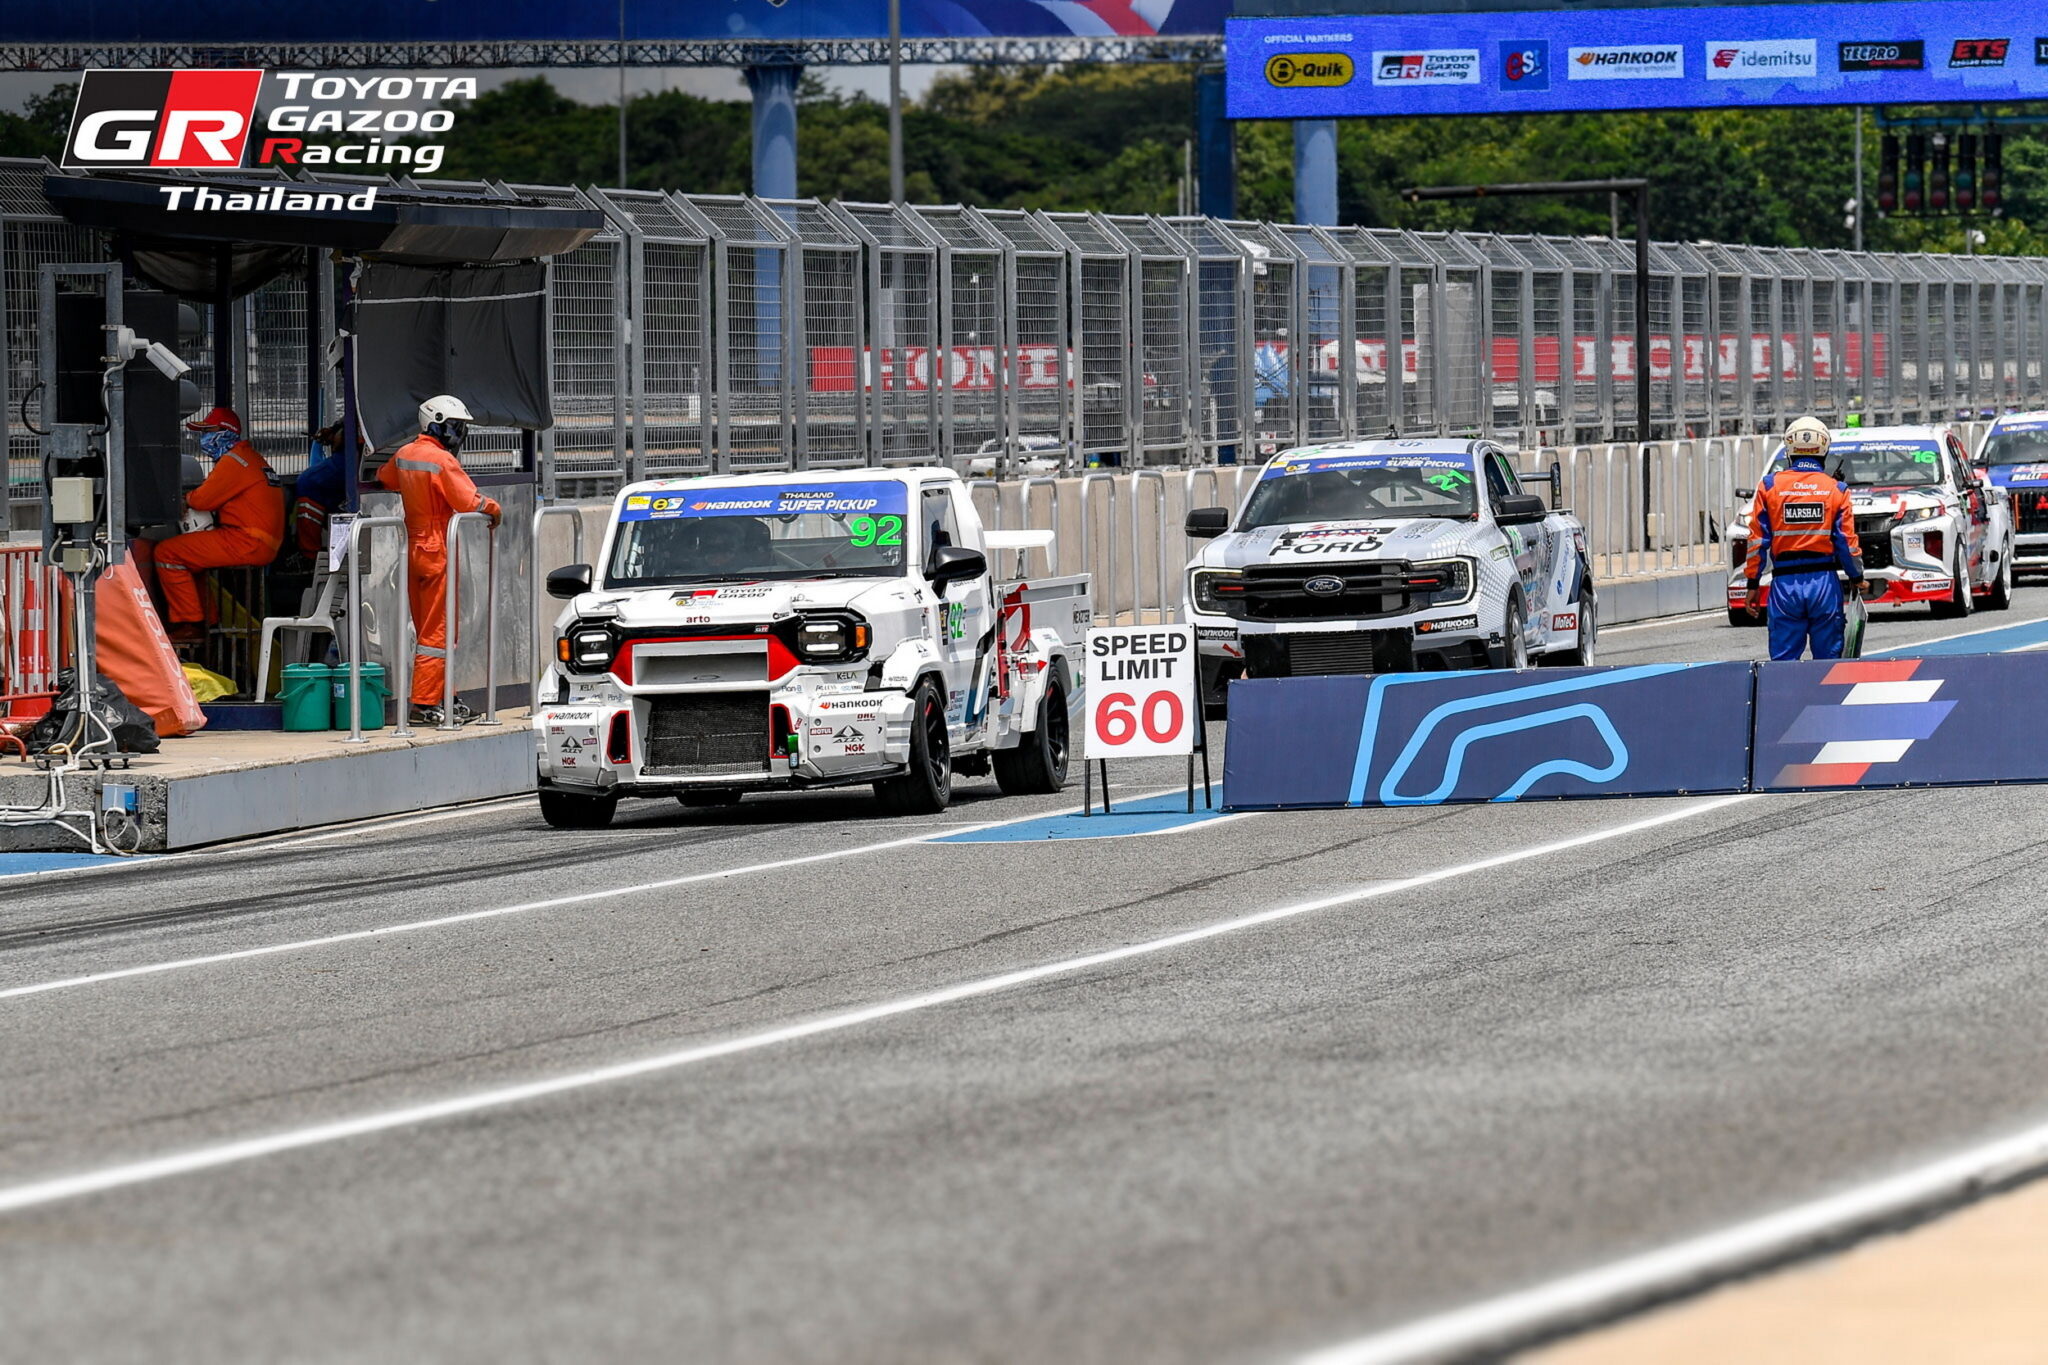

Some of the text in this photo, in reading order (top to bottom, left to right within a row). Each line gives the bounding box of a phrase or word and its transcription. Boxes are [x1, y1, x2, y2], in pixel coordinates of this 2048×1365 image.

[1264, 33, 1354, 43] OFFICIAL PARTNERS
[1843, 45, 1899, 62] TECPRO
[1954, 40, 2009, 59] ETS
[1427, 55, 1476, 63] TOYOTA
[1741, 49, 1812, 67] idemitsu
[1425, 63, 1470, 71] GAZOO
[864, 349, 1074, 387] HOND
[1424, 460, 1466, 468] PICKUP
[1911, 450, 1937, 464] 16
[784, 491, 834, 499] THAILAND
[777, 498, 878, 512] SUPER PICKUP
[1785, 507, 1821, 519] MARSHAL
[850, 515, 903, 548] 92
[1268, 540, 1384, 556] FORD
[686, 615, 711, 623] arto
[950, 602, 963, 640] 92
[1553, 615, 1575, 630] MoTeC
[1092, 632, 1187, 657] SPEED
[836, 671, 858, 681] KELA
[1101, 657, 1177, 681] LIMIT
[1095, 690, 1184, 746] 60
[844, 743, 865, 752] NGK
[561, 757, 576, 766] NGK
